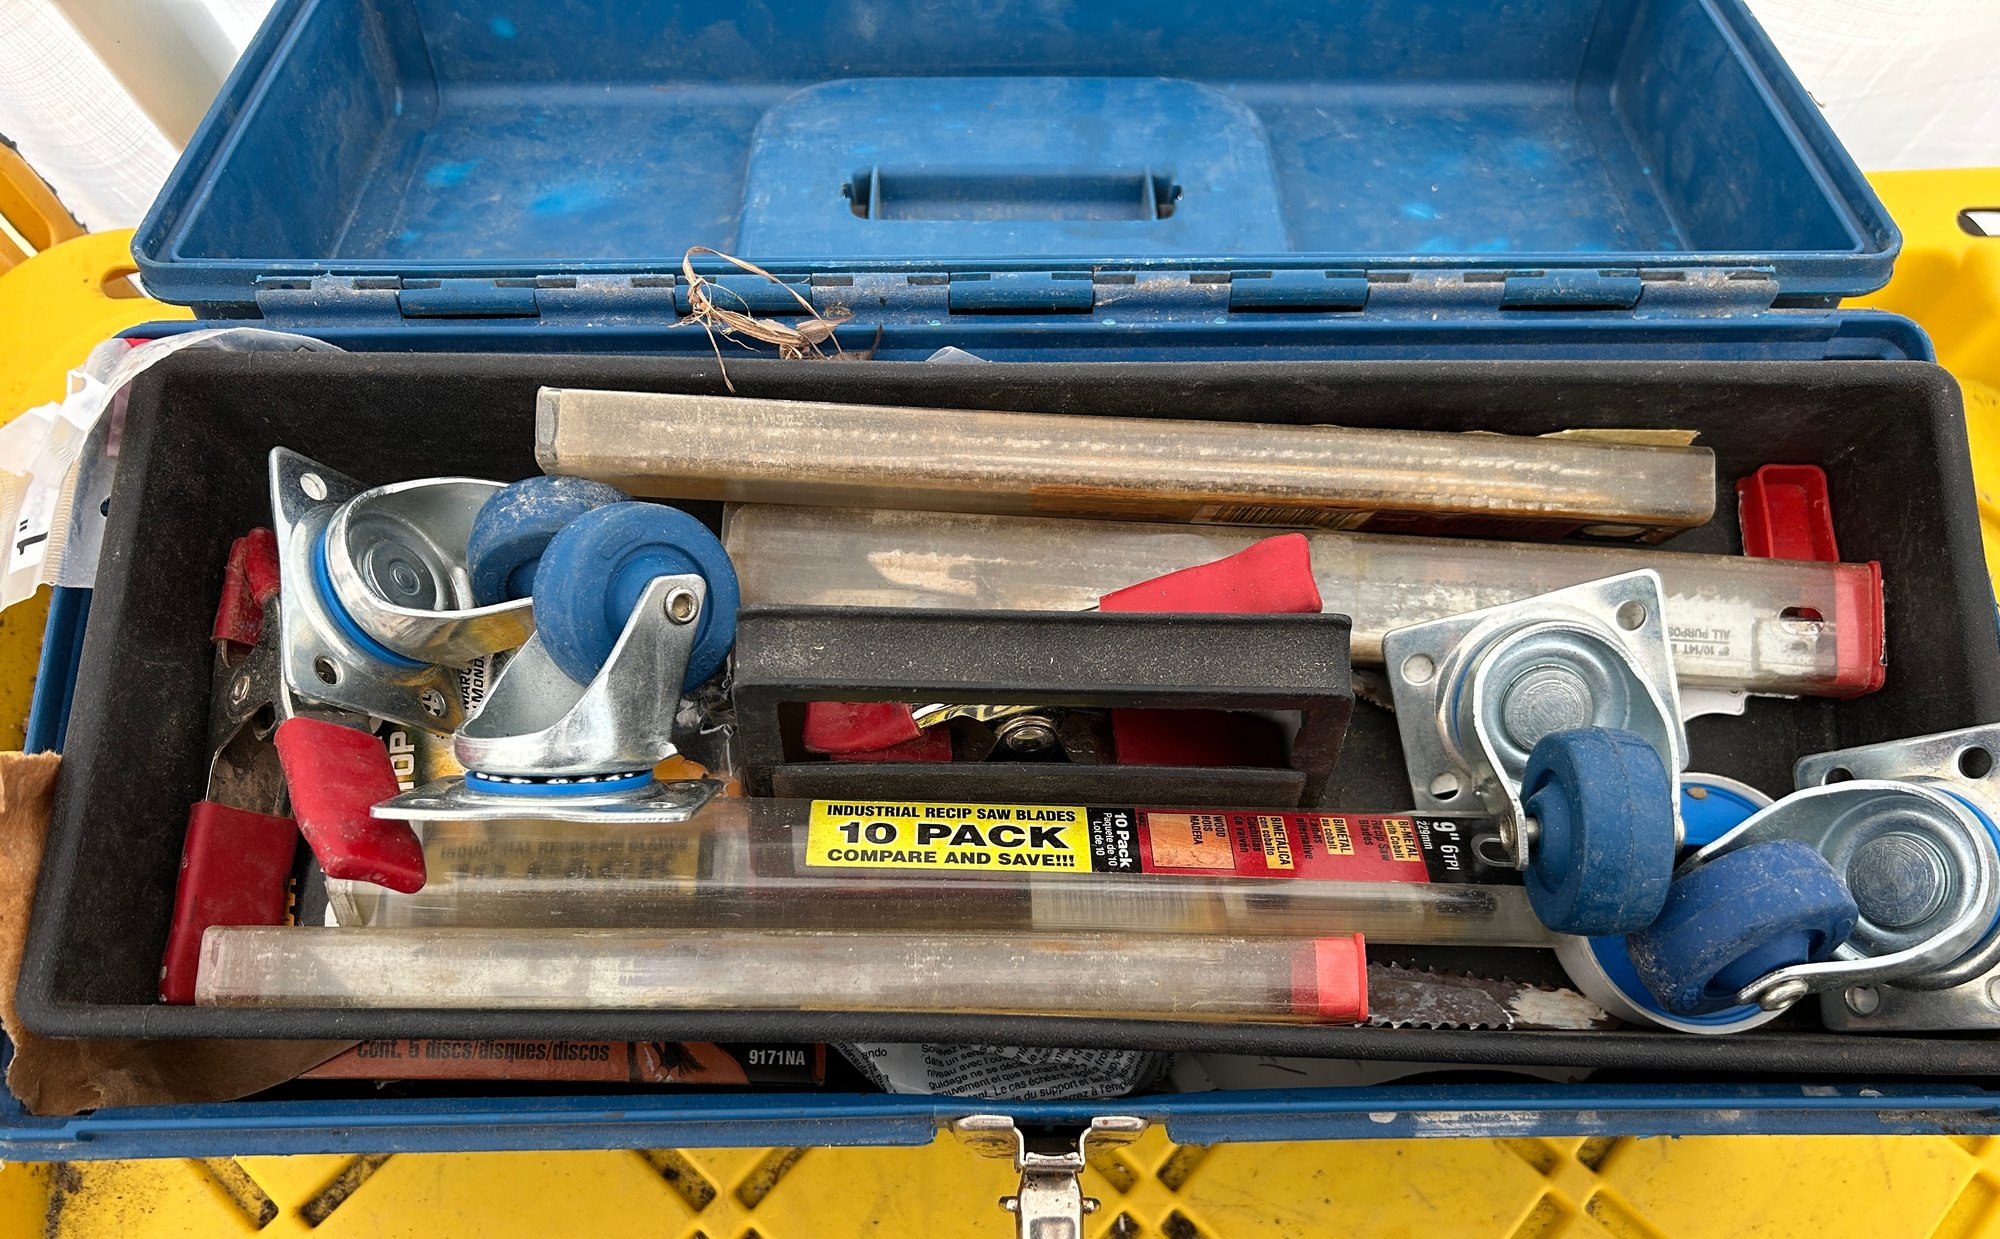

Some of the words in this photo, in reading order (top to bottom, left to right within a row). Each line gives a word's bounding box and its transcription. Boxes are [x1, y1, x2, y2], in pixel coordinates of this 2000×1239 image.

[1668, 626, 1709, 639] PURPOS
[1711, 628, 1731, 640] ALL
[827, 804, 920, 818] INDUSTRIAL
[925, 807, 972, 819] RECIP
[976, 808, 1011, 821] SAW
[1016, 810, 1076, 822] BLADES
[1114, 812, 1129, 828] 10
[1201, 816, 1213, 831] BOIS
[1233, 815, 1243, 826] de
[1259, 816, 1268, 829] con
[1321, 818, 1330, 827] au
[839, 822, 897, 845] 10
[917, 823, 1069, 849] PACK
[1093, 821, 1103, 834] Lot
[1102, 812, 1115, 843] Paquete
[1190, 816, 1203, 845] MADERA
[1213, 816, 1226, 837] WOOD
[1246, 816, 1261, 852] Cuchillas
[1309, 818, 1323, 844] Lames
[1333, 818, 1351, 853] BIMÉTAL
[1358, 819, 1373, 846] Blades
[1371, 819, 1386, 842] Recip
[1385, 820, 1396, 835] with
[1416, 820, 1433, 850] 229mm
[1433, 821, 1460, 841] 9"
[1094, 834, 1104, 845] de
[1116, 830, 1133, 868] Pack
[1262, 829, 1275, 856] cobalto
[1296, 817, 1313, 860] alternative
[1324, 828, 1338, 850] cobalt
[1390, 835, 1405, 859] Cobalt
[1397, 820, 1419, 858] BI-METAL
[827, 849, 937, 864] COMPARE
[944, 851, 991, 865] AND
[998, 853, 1075, 867] SAVE!!!
[1095, 847, 1106, 856] 10
[1106, 844, 1116, 855] de
[1378, 843, 1391, 862] Saw
[1440, 844, 1460, 870] 6TPI
[1107, 856, 1118, 867] 10
[357, 1040, 401, 1059] Cont.
[408, 1040, 420, 1059] 5
[425, 1040, 610, 1064] discs/disques/discos
[749, 1049, 806, 1066] 9171NA
[945, 1056, 959, 1066] un
[927, 1067, 957, 1079] niveau
[959, 1059, 983, 1071] avec
[928, 1074, 968, 1091] guidage
[970, 1069, 984, 1078] ne
[985, 1066, 999, 1074] se
[931, 1078, 991, 1096] mouvement
[990, 1075, 1002, 1083] et
[1002, 1071, 1021, 1082] que
[1021, 1068, 1031, 1076] le
[1032, 1064, 1059, 1075] chant
[993, 1084, 1007, 1097] Le
[1009, 1080, 1027, 1092] cas
[1028, 1072, 1070, 1087] échéant,
[1023, 1090, 1037, 1100] du
[1039, 1080, 1078, 1097] support
[1078, 1078, 1090, 1086] et
[1091, 1086, 1098, 1097] à
